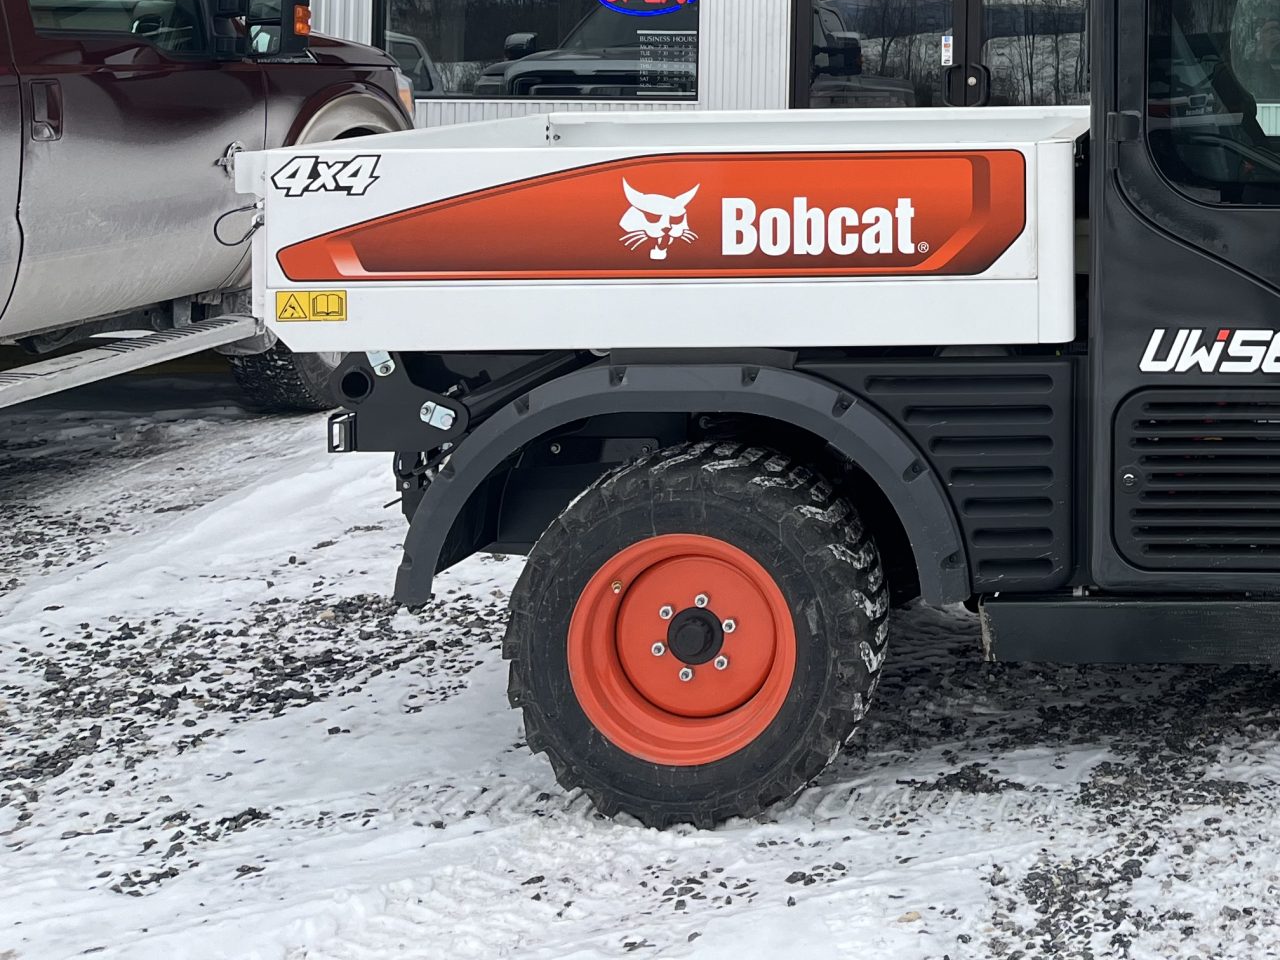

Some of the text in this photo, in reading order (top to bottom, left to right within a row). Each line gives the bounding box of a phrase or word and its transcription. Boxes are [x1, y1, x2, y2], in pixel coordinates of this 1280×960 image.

[640, 35, 697, 43] BUSINESS HOURS
[271, 155, 381, 197] 4x4
[721, 196, 915, 256] Bobcat
